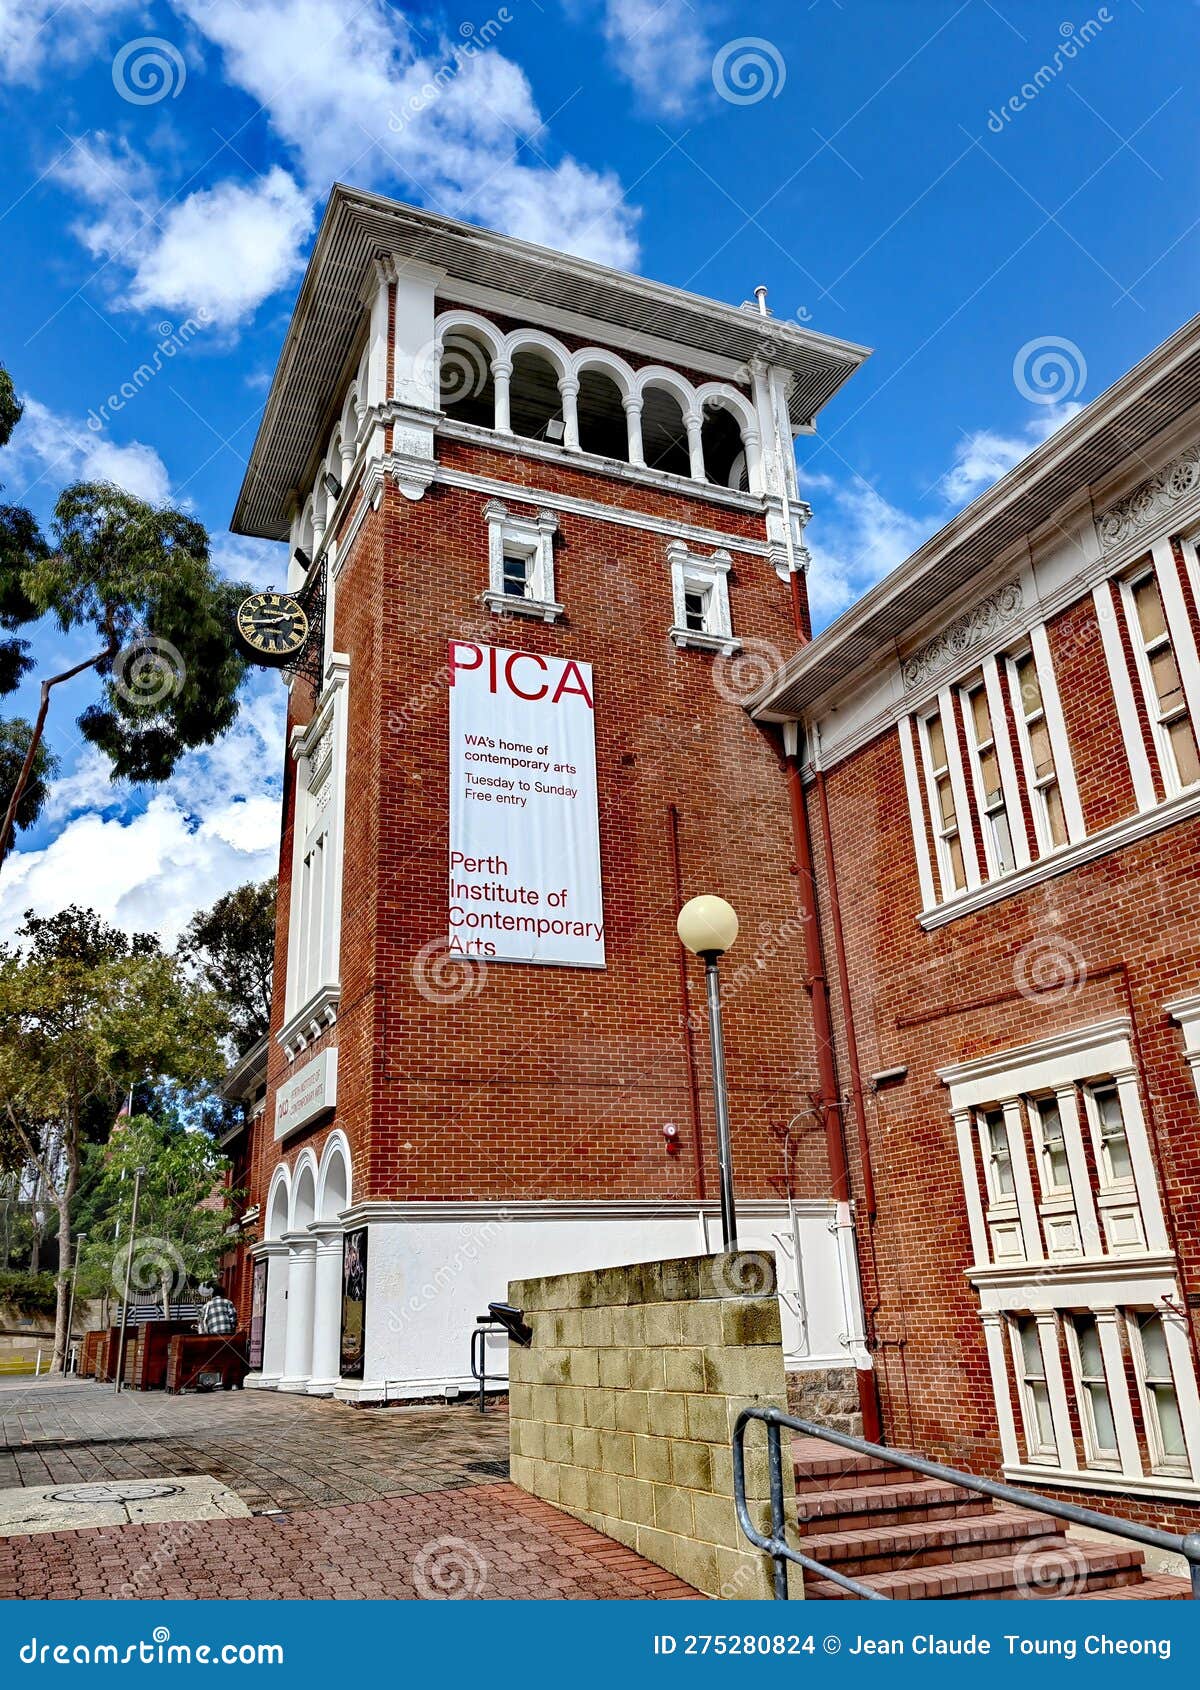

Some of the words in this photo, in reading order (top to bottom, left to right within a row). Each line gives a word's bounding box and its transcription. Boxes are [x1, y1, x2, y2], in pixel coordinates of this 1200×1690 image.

[449, 641, 594, 709] PICA
[464, 734, 496, 749] WA’s
[499, 739, 533, 754] home
[536, 745, 549, 756] of
[464, 751, 550, 773] contemporary
[553, 764, 577, 775] arts
[464, 772, 516, 791] Tuesday
[518, 780, 531, 792] to
[534, 782, 578, 799] Sunday
[465, 788, 492, 802] Free
[496, 794, 527, 807] entry
[450, 851, 508, 876] Perth
[450, 878, 539, 906] Institute
[547, 889, 568, 908] of
[449, 906, 604, 942] Contemporary
[449, 934, 496, 956] Arts
